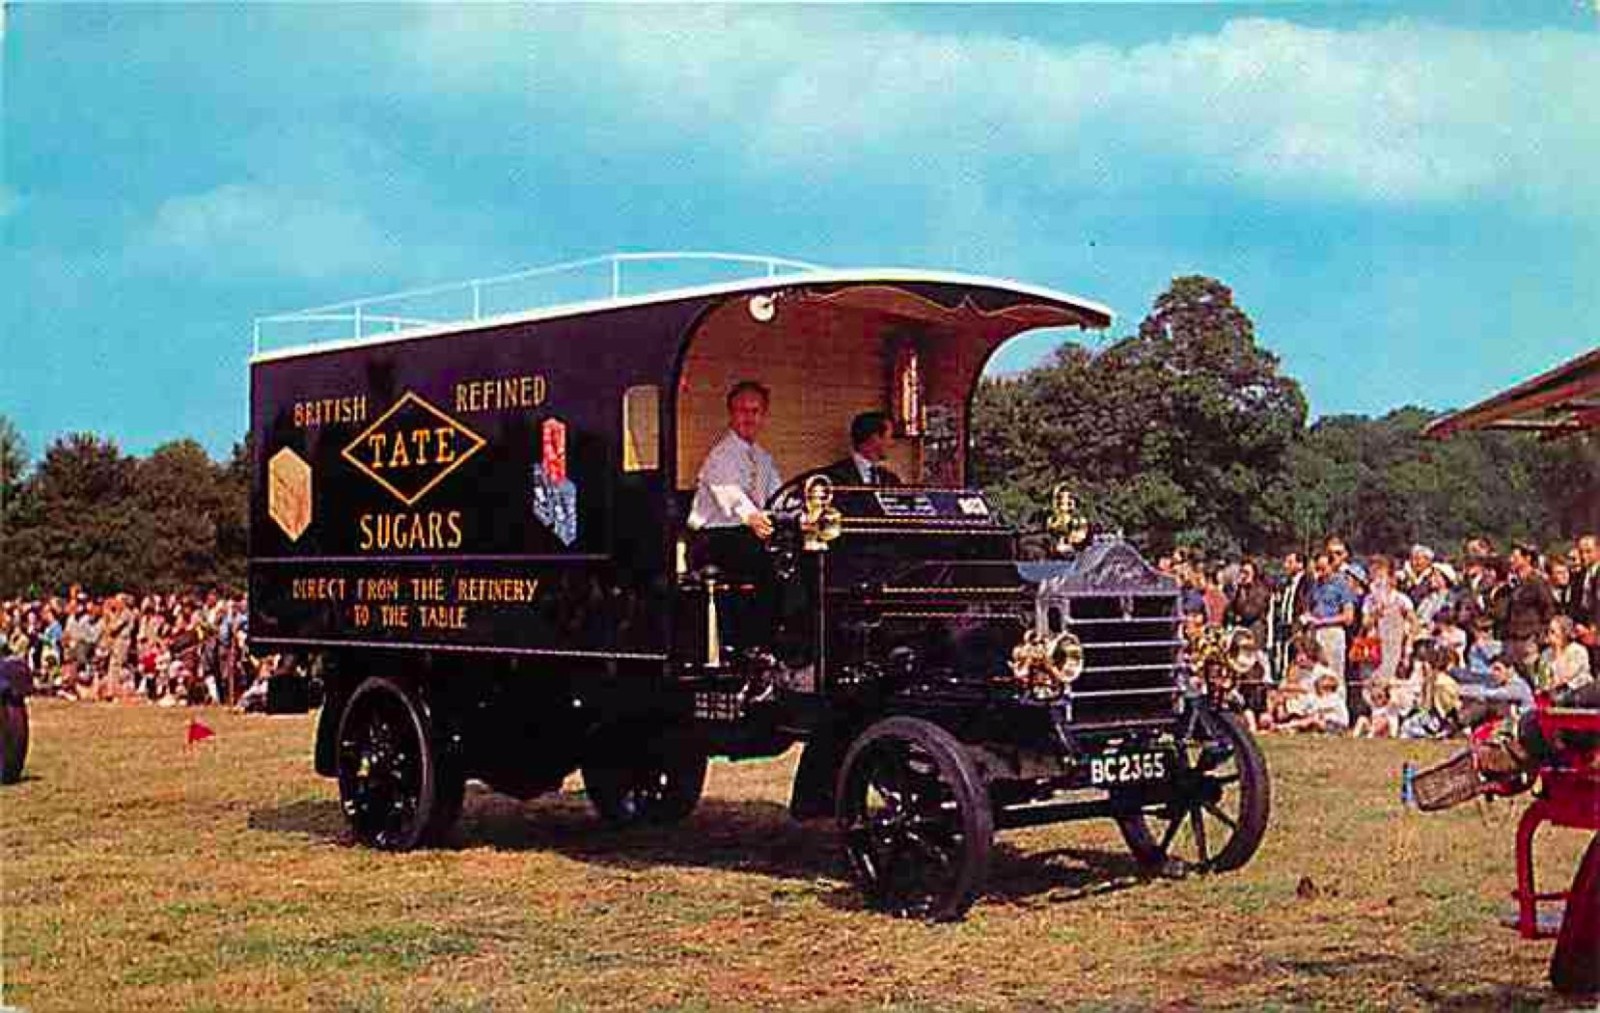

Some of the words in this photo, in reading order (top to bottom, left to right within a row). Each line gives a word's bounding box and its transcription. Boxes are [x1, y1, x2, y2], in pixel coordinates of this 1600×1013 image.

[294, 396, 367, 427] BRITISH
[455, 376, 547, 412] REFINED
[368, 427, 456, 468] TATE
[359, 511, 463, 549] SUGARS
[292, 578, 346, 599] DIRECT
[356, 578, 398, 600] FROM
[411, 578, 445, 600] THE
[457, 578, 538, 602] REFINERY
[354, 605, 369, 626] TO
[382, 606, 408, 628] THE
[420, 606, 467, 628] TABLE
